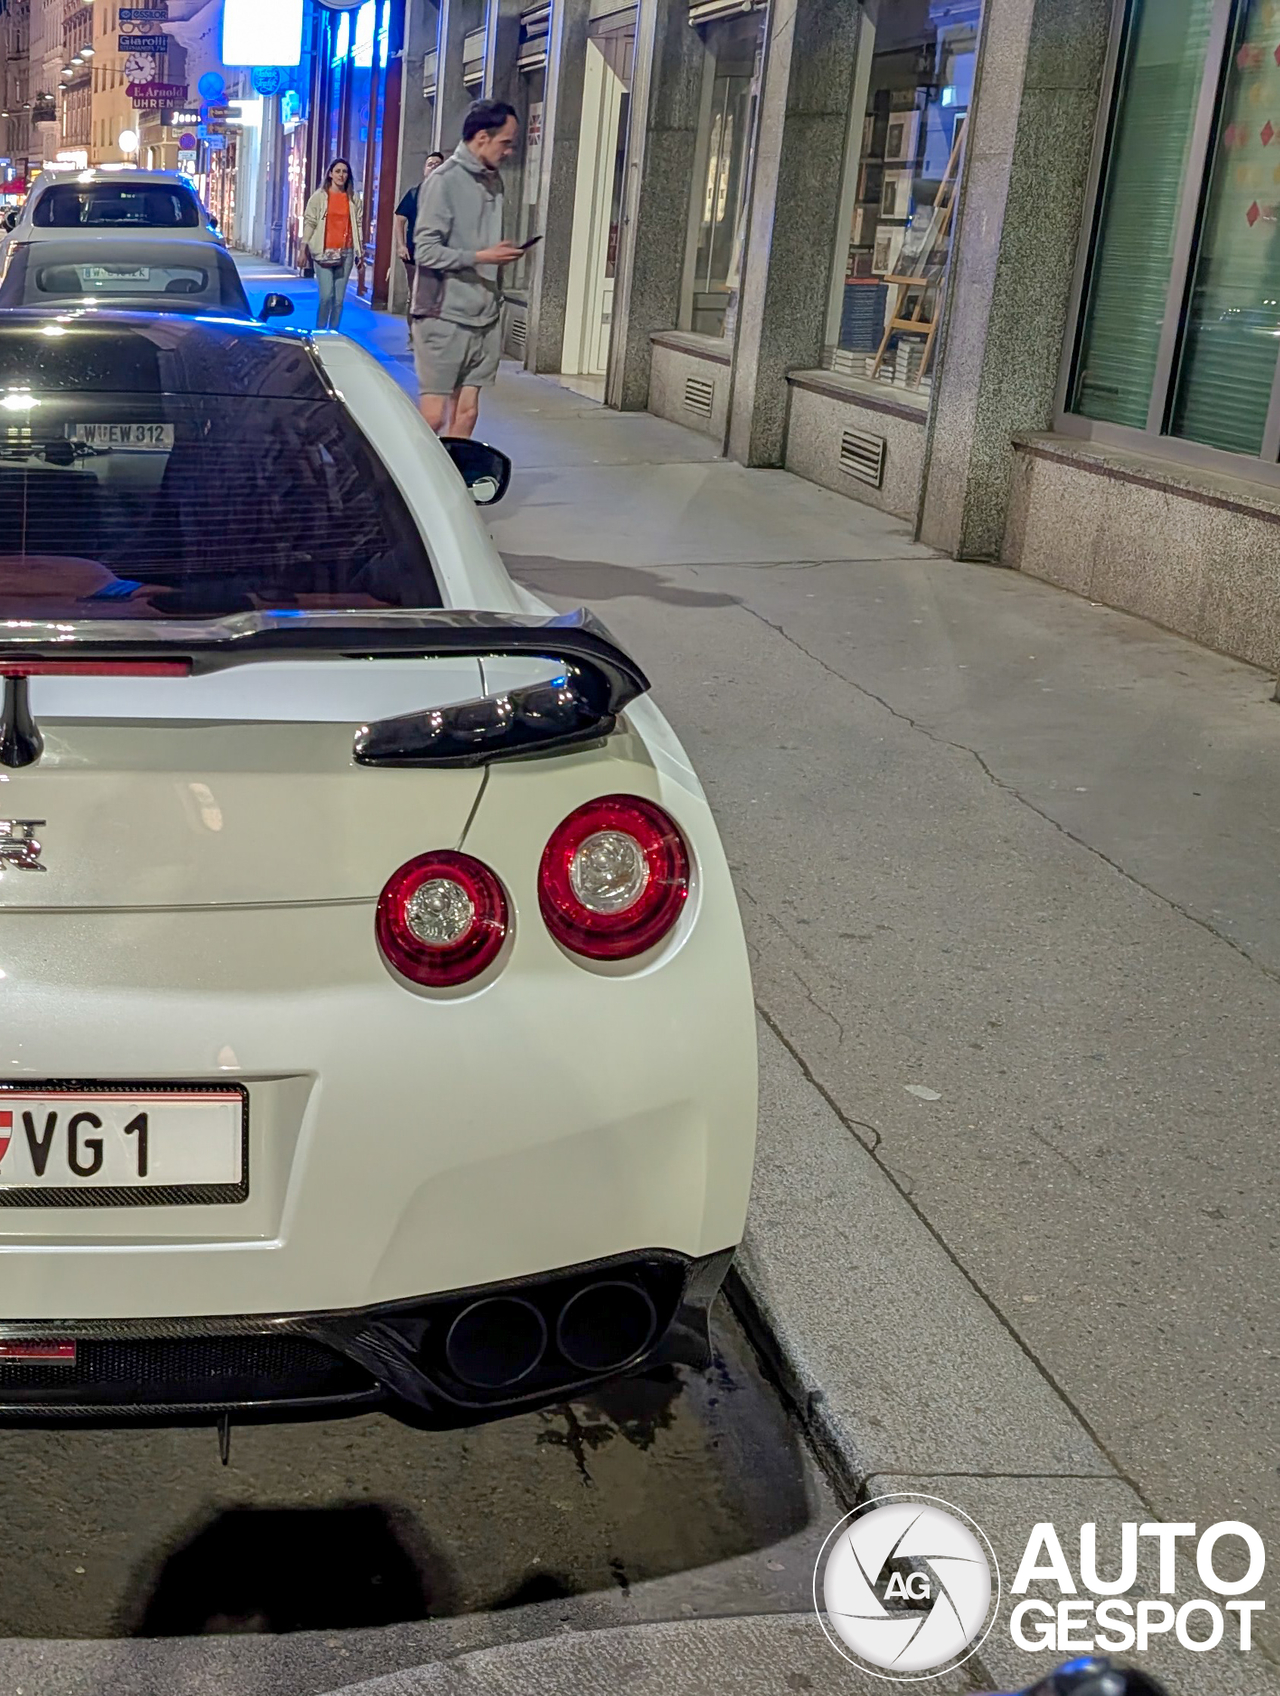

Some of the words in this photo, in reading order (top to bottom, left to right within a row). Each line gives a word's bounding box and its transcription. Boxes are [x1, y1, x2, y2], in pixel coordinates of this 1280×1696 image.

[120, 36, 166, 46] Giarolli
[134, 87, 144, 97] E.
[145, 87, 184, 97] Arnold
[133, 99, 174, 108] UHREN
[84, 425, 96, 442] W
[109, 425, 131, 442] EW
[136, 425, 165, 442] 312
[21, 1110, 105, 1178] VG
[123, 1111, 149, 1178] 1
